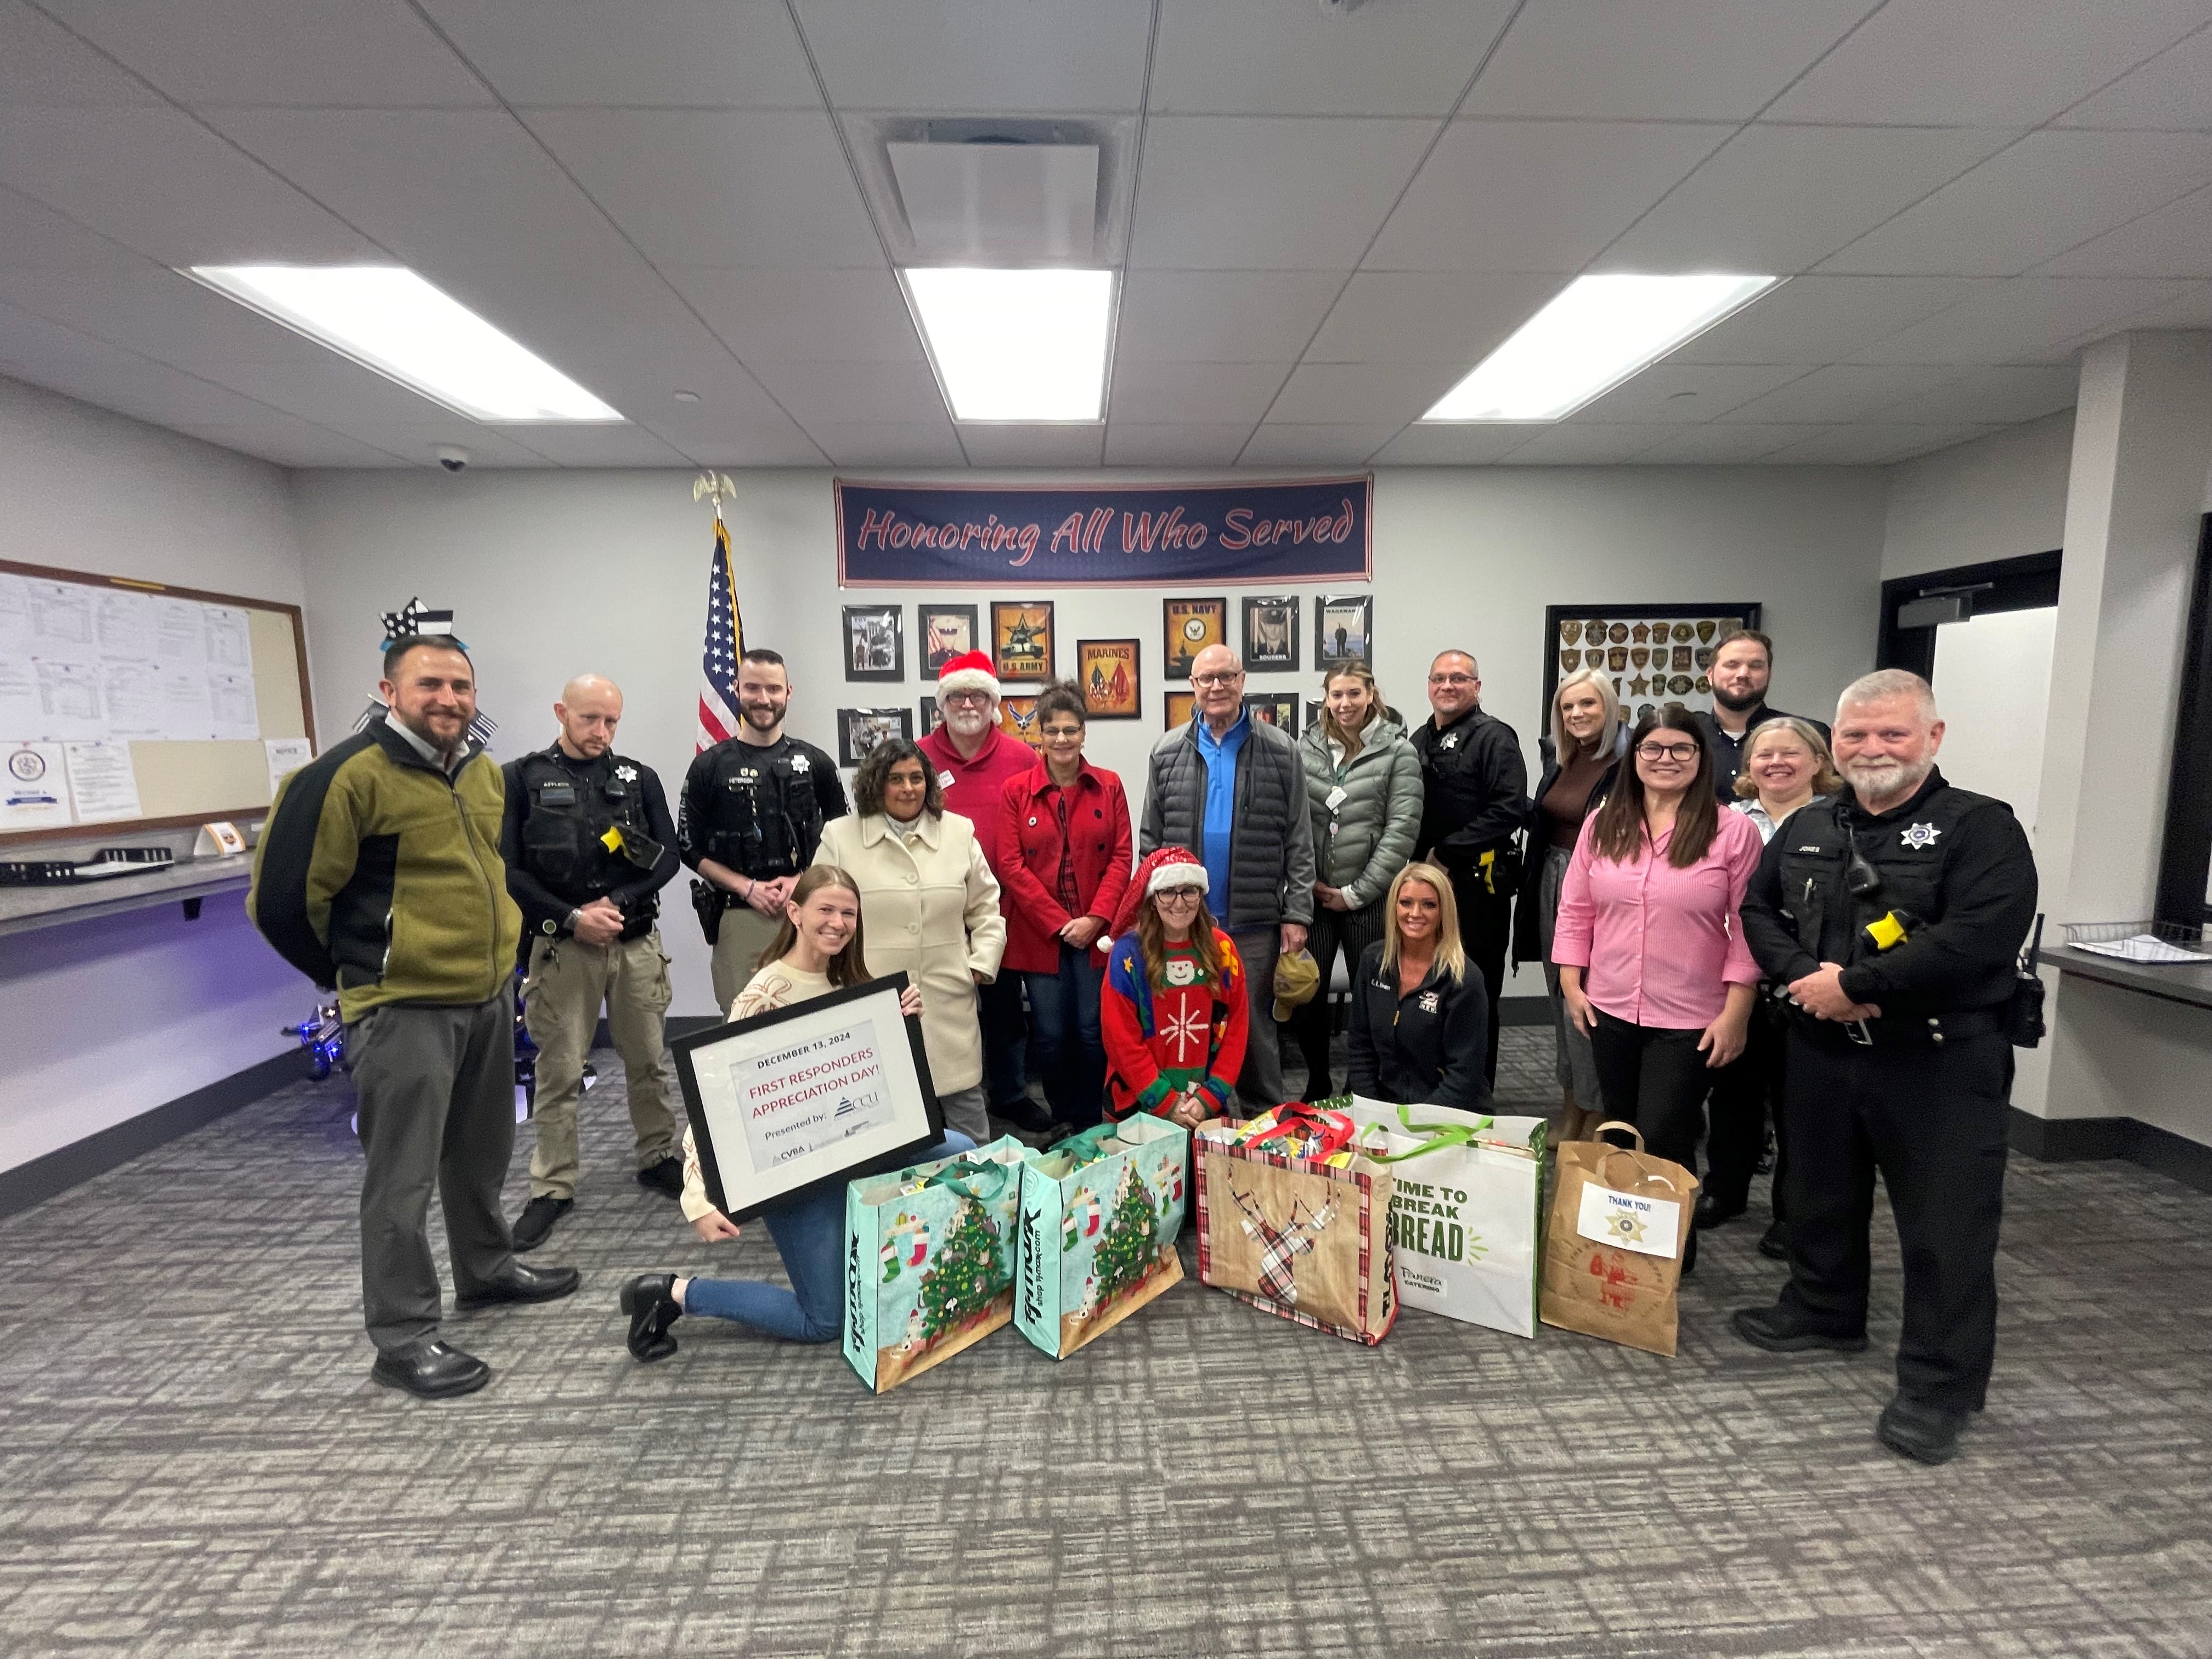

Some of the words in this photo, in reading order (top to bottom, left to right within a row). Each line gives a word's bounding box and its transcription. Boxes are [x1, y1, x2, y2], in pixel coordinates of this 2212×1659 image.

[857, 507, 1041, 567] Honoring
[1050, 507, 1115, 554] All
[1122, 505, 1208, 554] Who
[1219, 497, 1354, 550] Served
[1172, 605, 1189, 615] U.S.
[1192, 605, 1217, 615] NAVY
[1087, 648, 1130, 660] MARINES
[1020, 662, 1043, 672] ARMY
[757, 1046, 810, 1069] DECEMBER
[812, 1041, 827, 1051] 13,
[828, 1031, 851, 1045] 2024
[749, 1077, 786, 1099] FIRST
[789, 1047, 873, 1086] RESPONDERS
[753, 1076, 848, 1119] APPRECIATION
[850, 1064, 880, 1083] DAY!
[764, 1117, 811, 1141] Presented
[812, 1113, 827, 1123] by:
[781, 1146, 805, 1160] CVBA
[1440, 1186, 1468, 1204] TO
[1608, 1195, 1633, 1209] THANK
[1634, 1200, 1651, 1212] YOU!
[1391, 1195, 1459, 1220] BREAK
[1400, 1266, 1442, 1286] Panera
[1404, 1280, 1440, 1293] CATERING
